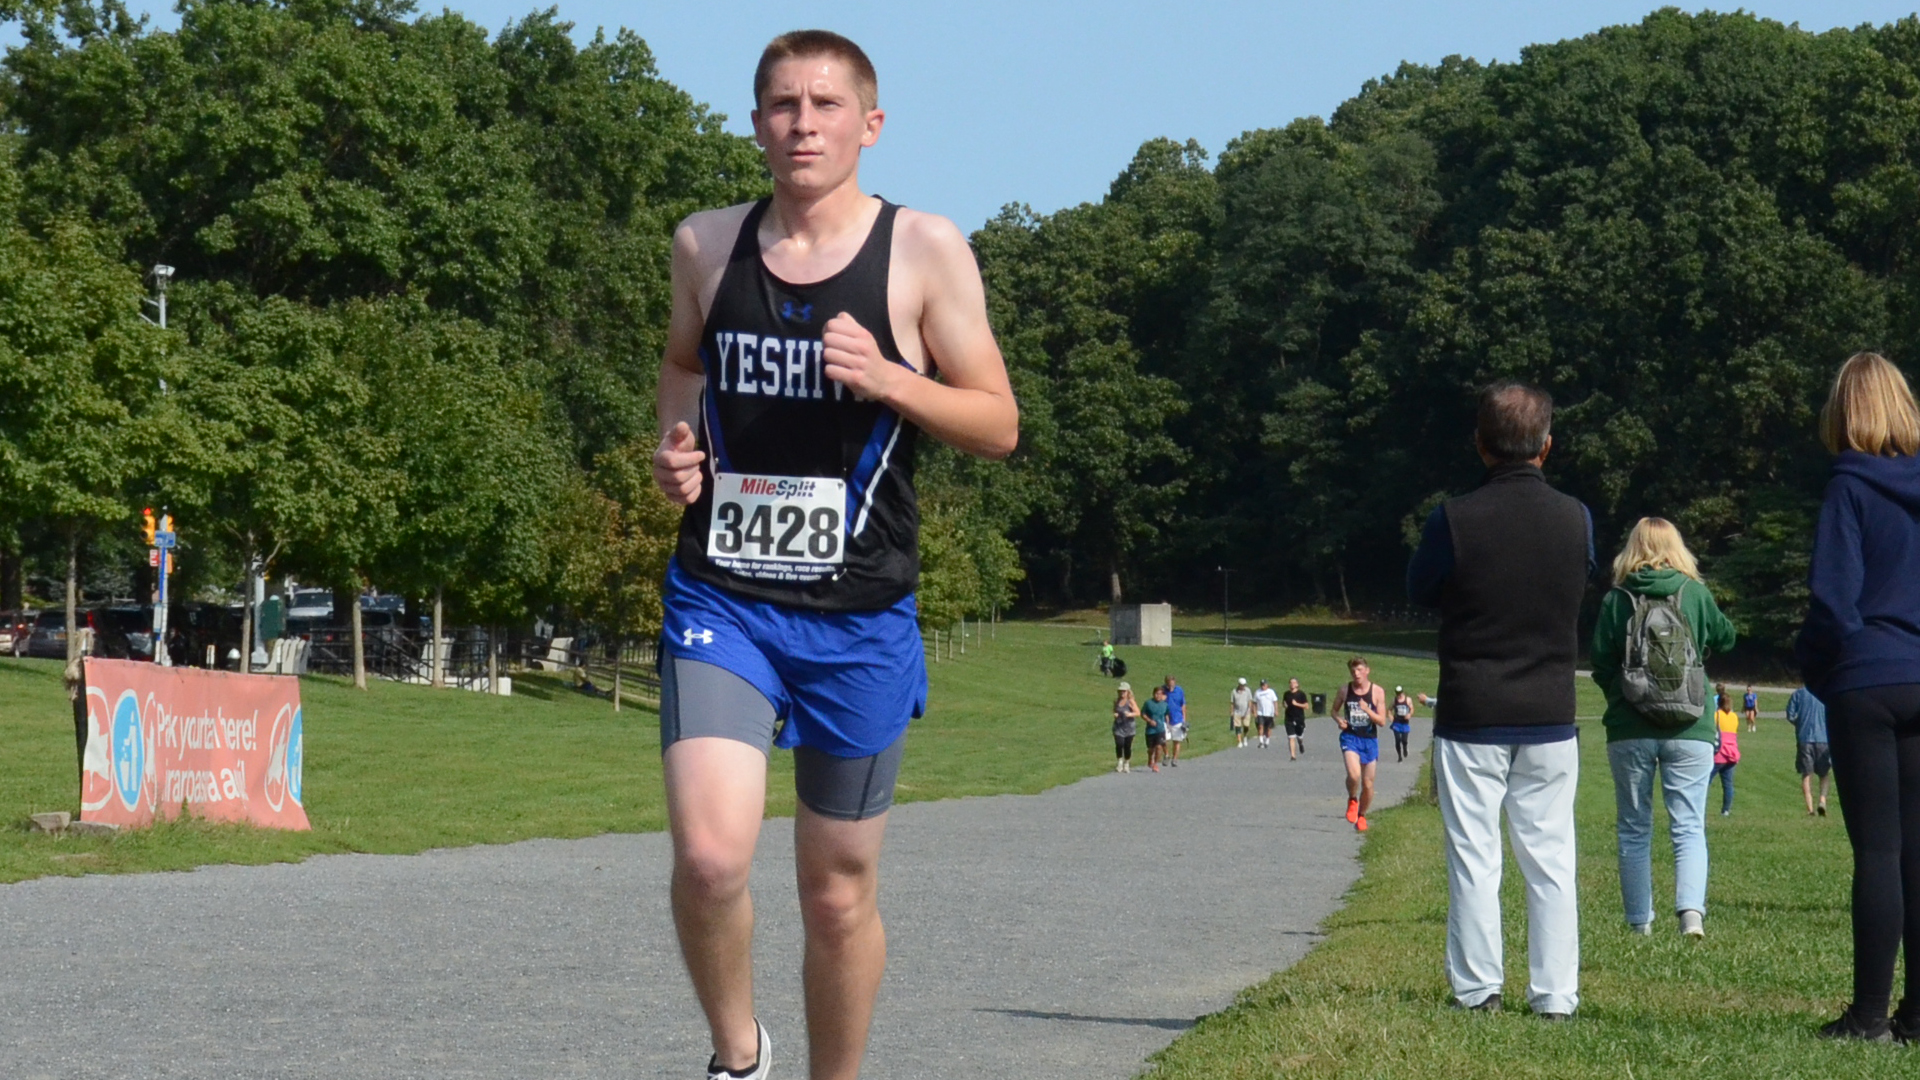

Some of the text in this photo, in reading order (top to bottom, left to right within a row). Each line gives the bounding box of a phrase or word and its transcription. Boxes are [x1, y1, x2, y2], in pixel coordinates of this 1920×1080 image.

[716, 332, 866, 401] YESHI
[740, 478, 816, 500] MileSplit
[715, 501, 839, 560] 3428
